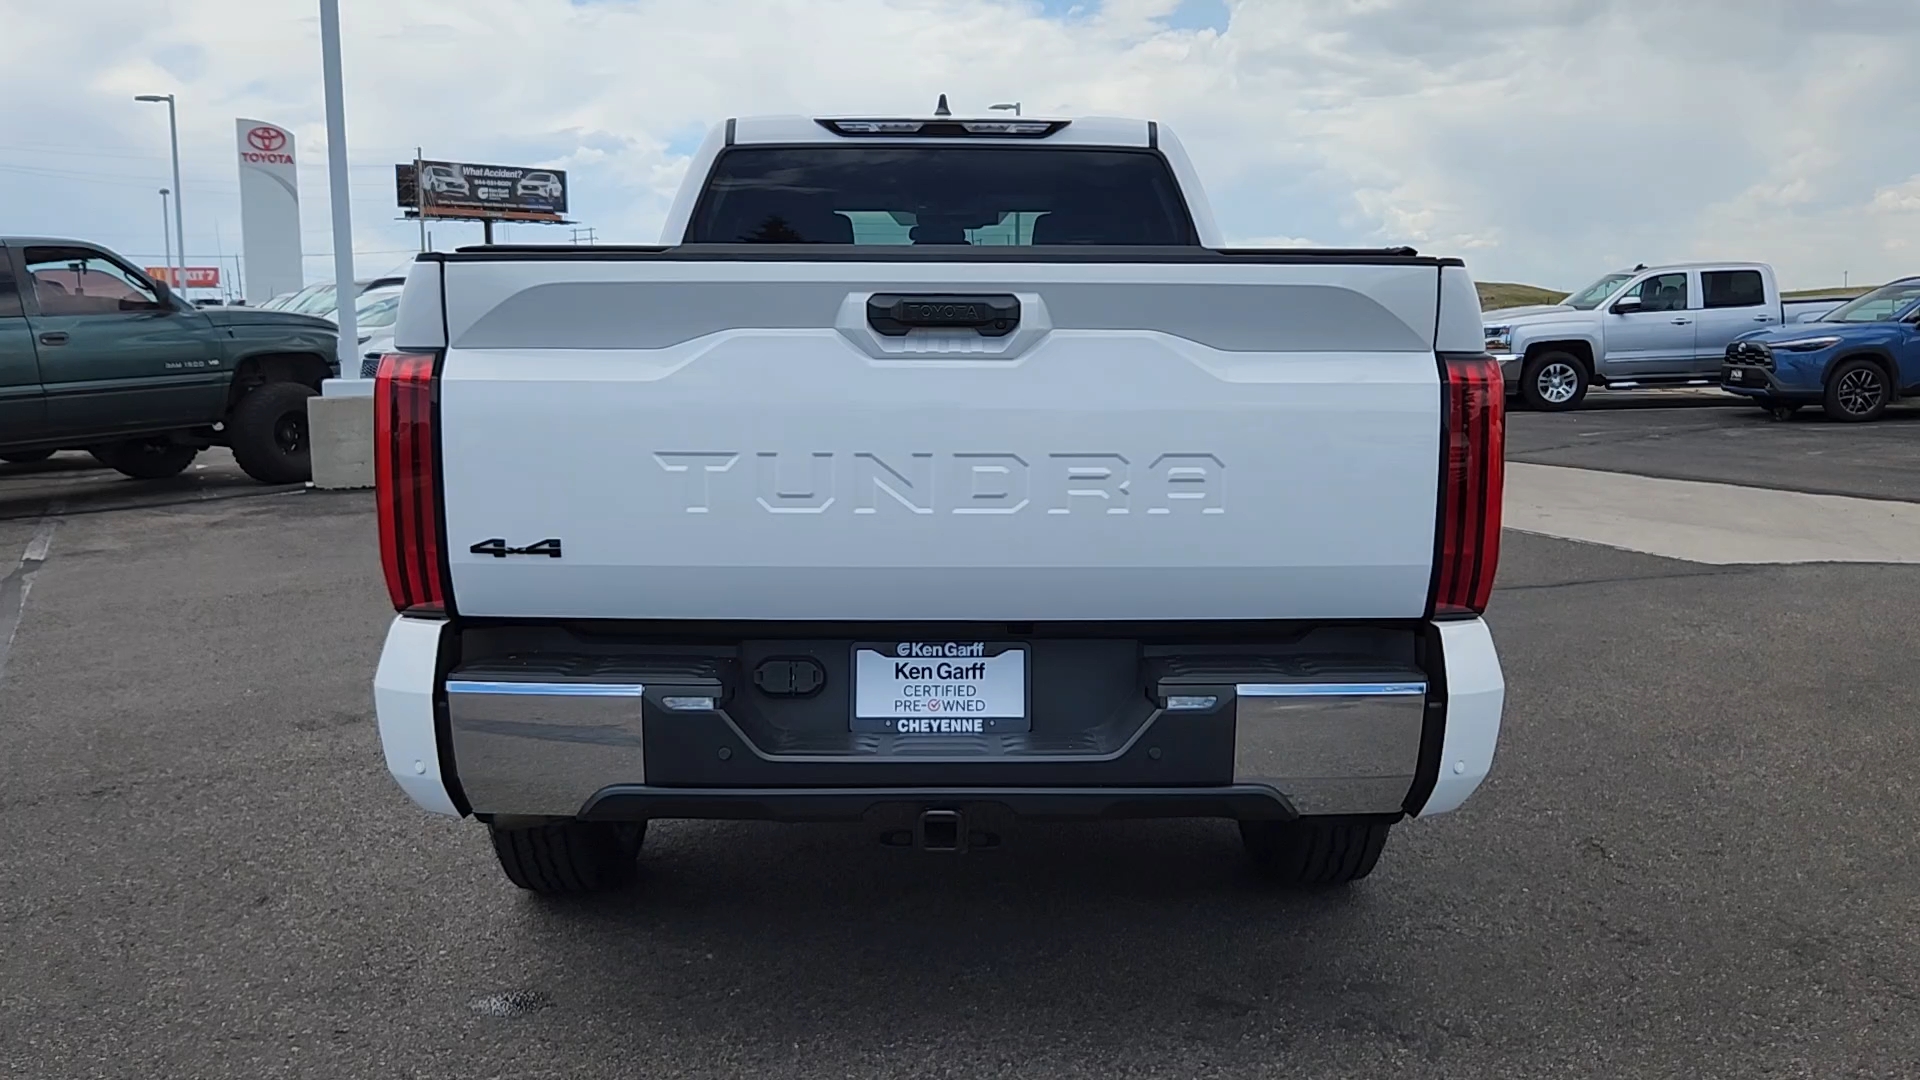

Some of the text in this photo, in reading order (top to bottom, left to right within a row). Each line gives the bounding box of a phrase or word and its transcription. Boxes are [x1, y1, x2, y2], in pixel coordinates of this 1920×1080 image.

[241, 152, 294, 164] TOYOTA
[463, 166, 523, 179] What Accident?
[206, 269, 215, 281] 7
[910, 305, 979, 319] TOYOTA
[653, 451, 1226, 515] TUNDRA
[912, 642, 985, 657] Ken Garff
[895, 662, 986, 680] Ken Garff
[903, 685, 977, 697] CERTIFIED
[897, 719, 984, 733] CHEYENNE
